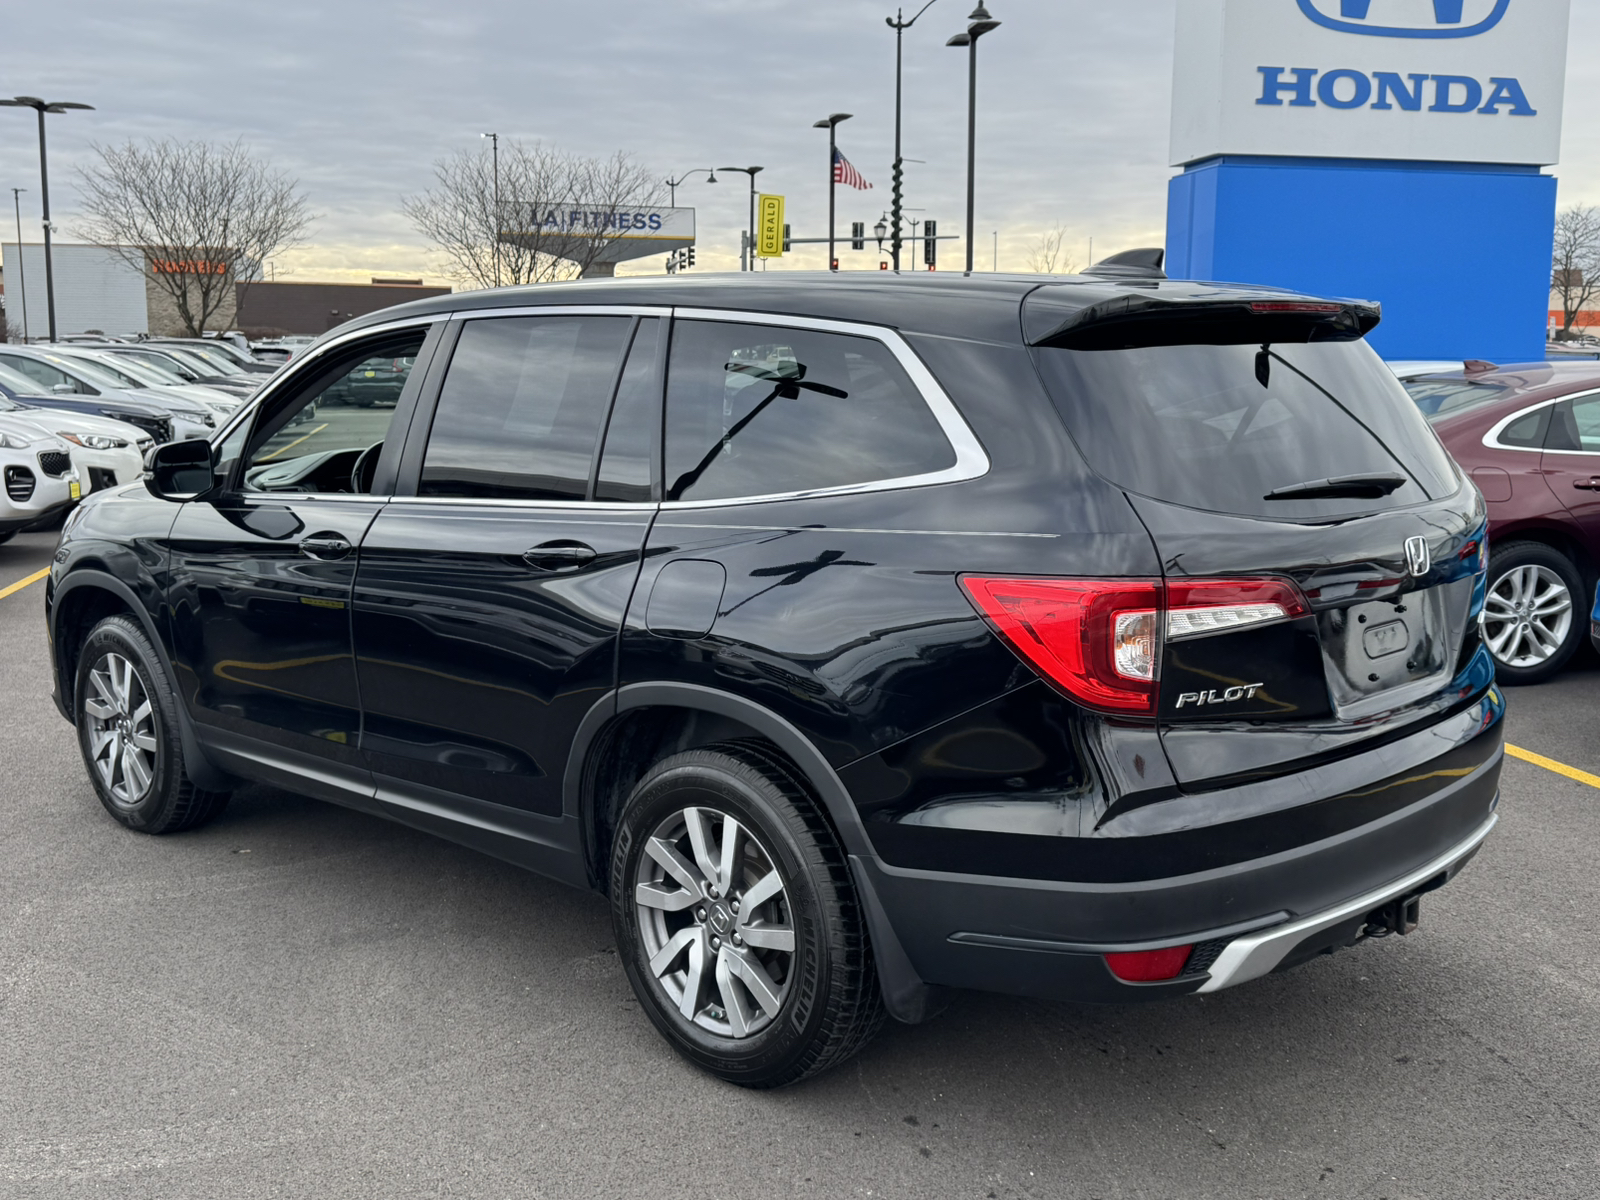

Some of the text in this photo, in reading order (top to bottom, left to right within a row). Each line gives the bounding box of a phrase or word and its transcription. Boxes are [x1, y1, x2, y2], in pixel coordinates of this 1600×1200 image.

[1255, 66, 1537, 117] HONDA
[569, 210, 662, 231] FITNESS
[765, 202, 776, 249] GERALD
[1174, 682, 1264, 709] PILOT
[795, 916, 817, 1028] MICHELIN
